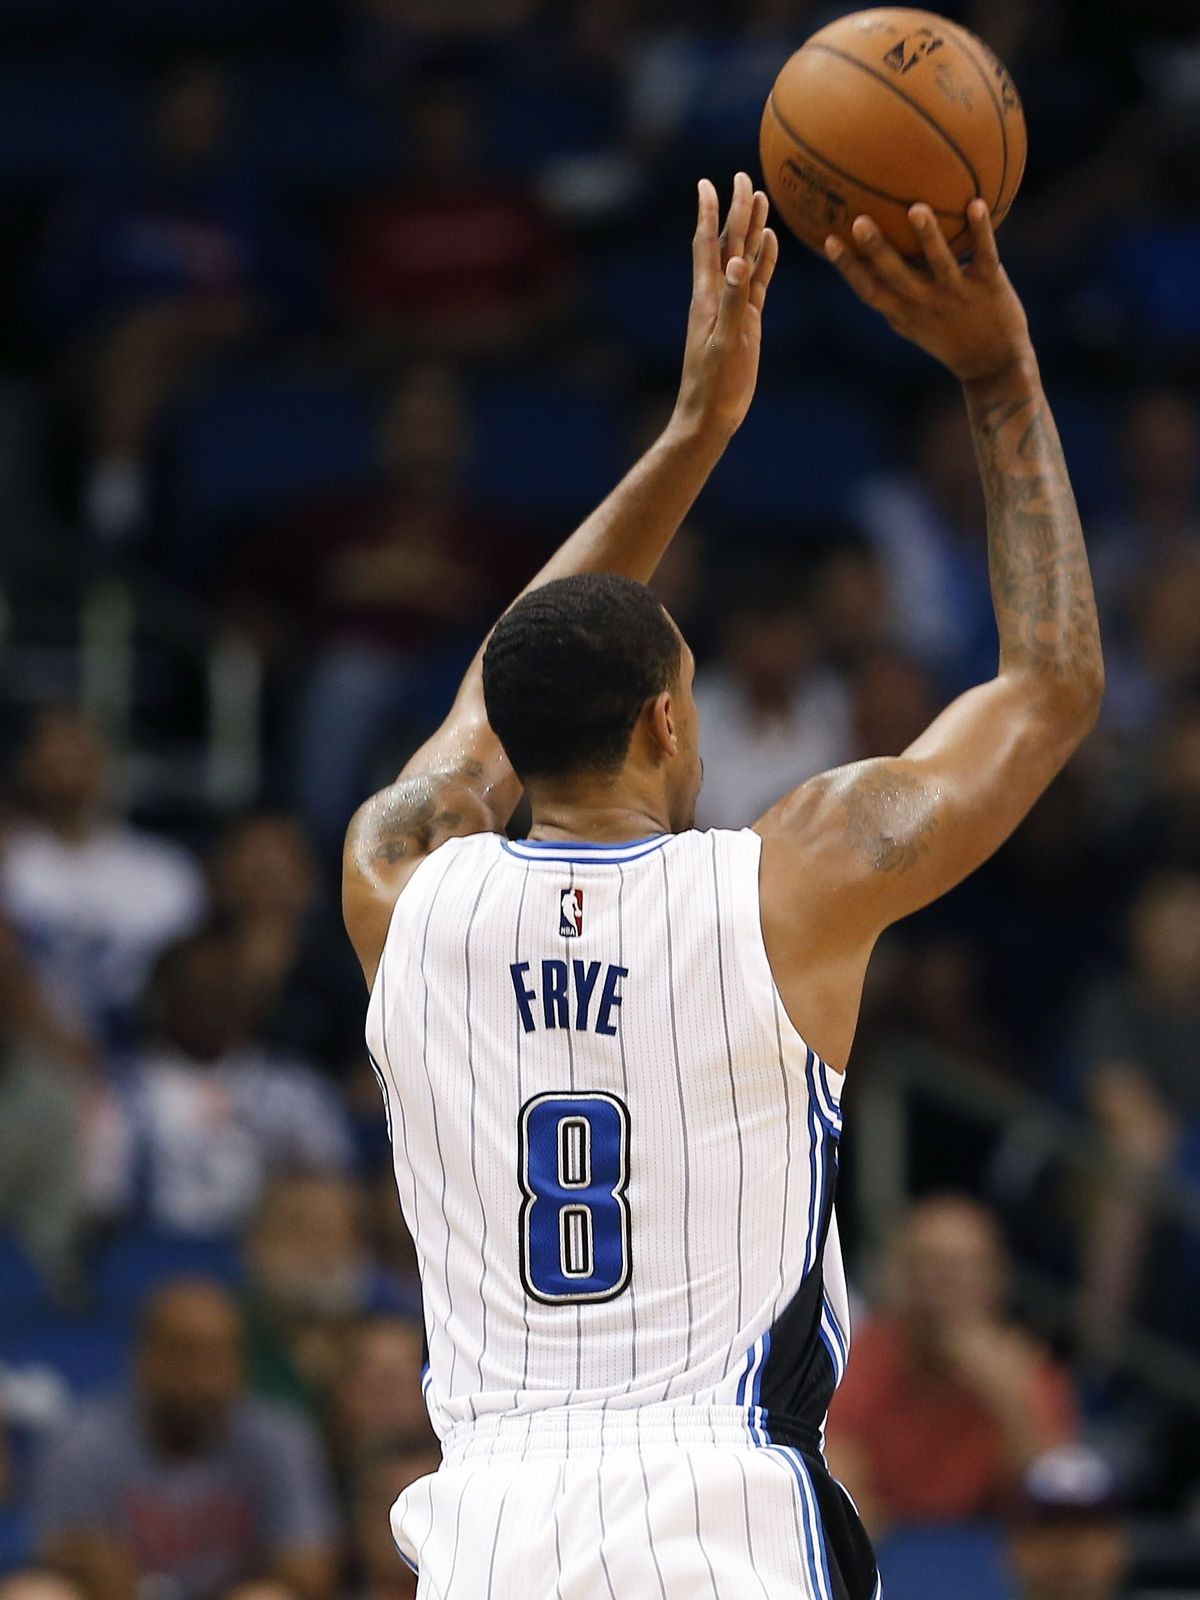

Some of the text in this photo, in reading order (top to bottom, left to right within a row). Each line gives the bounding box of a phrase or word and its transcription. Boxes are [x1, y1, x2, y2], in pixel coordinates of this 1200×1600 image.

[560, 926, 575, 936] NBA
[509, 959, 629, 1036] FRYE
[517, 1090, 633, 1306] 8
